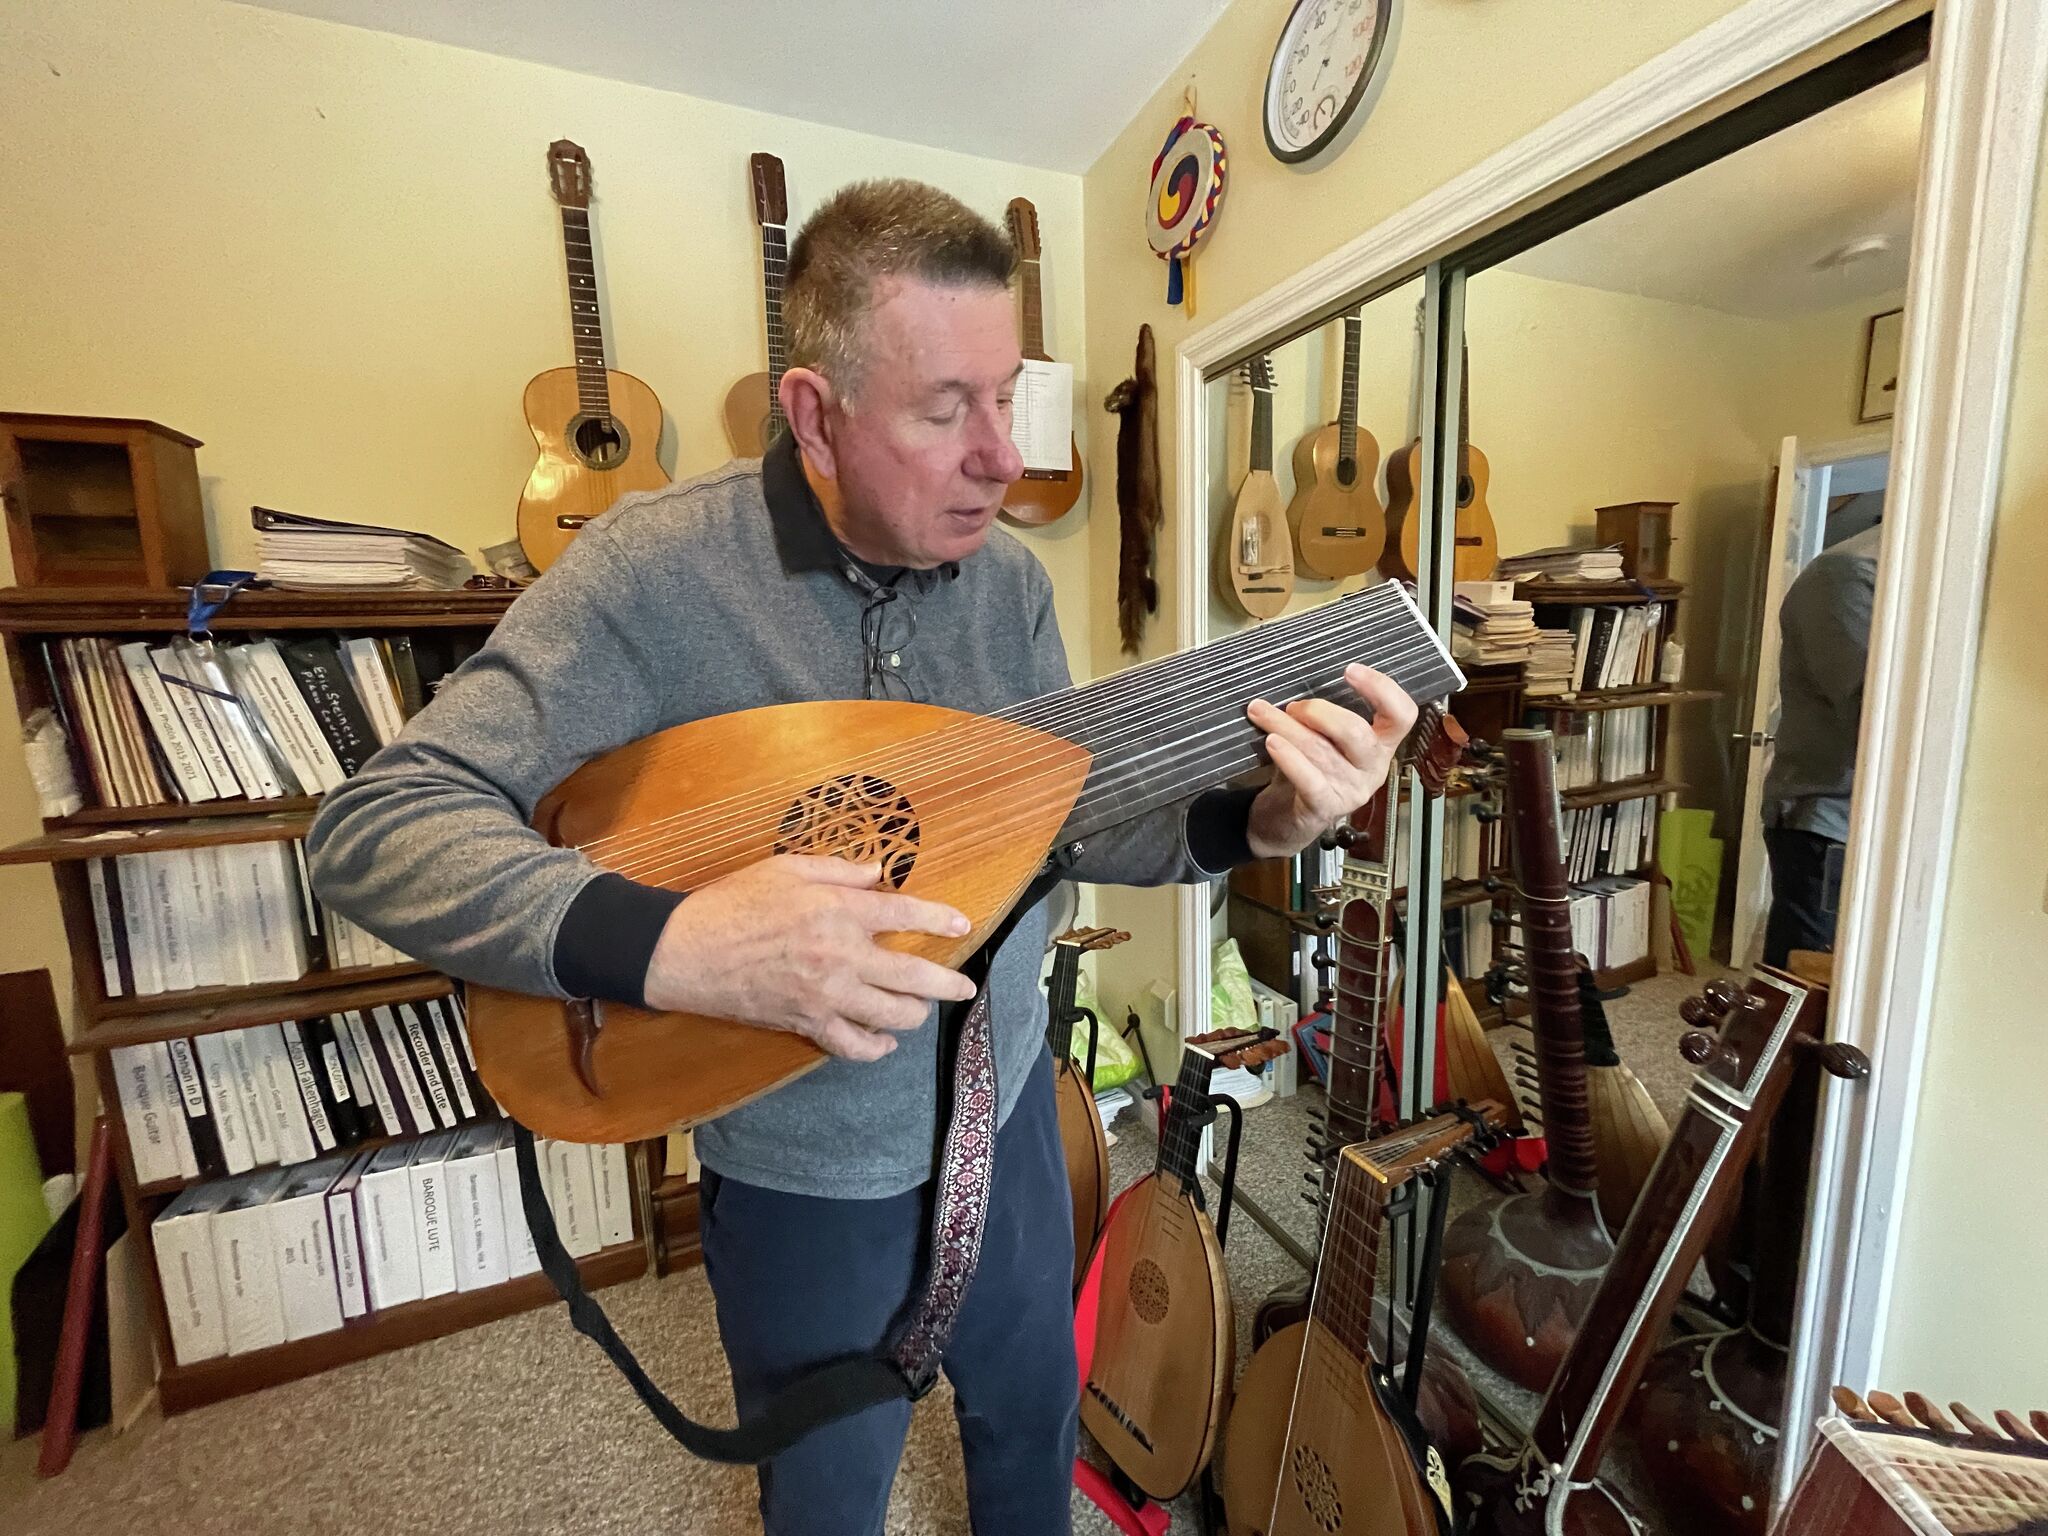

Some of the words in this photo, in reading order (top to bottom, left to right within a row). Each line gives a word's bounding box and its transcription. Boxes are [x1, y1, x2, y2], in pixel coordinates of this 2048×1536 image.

[312, 663, 332, 691] Eric
[211, 753, 227, 778] Music
[171, 1039, 194, 1083] Cannon
[288, 1038, 311, 1070] Adam
[407, 1022, 433, 1067] Recorder
[424, 1067, 440, 1087] and
[432, 1087, 449, 1109] Lute
[132, 1064, 153, 1111] Baroque
[184, 1082, 199, 1096] in
[188, 1095, 202, 1107] D
[298, 1069, 328, 1133] Falkenhagen
[142, 1111, 161, 1146] Guitar
[420, 1177, 437, 1226] BAROQUE
[426, 1226, 441, 1251] LUTE
